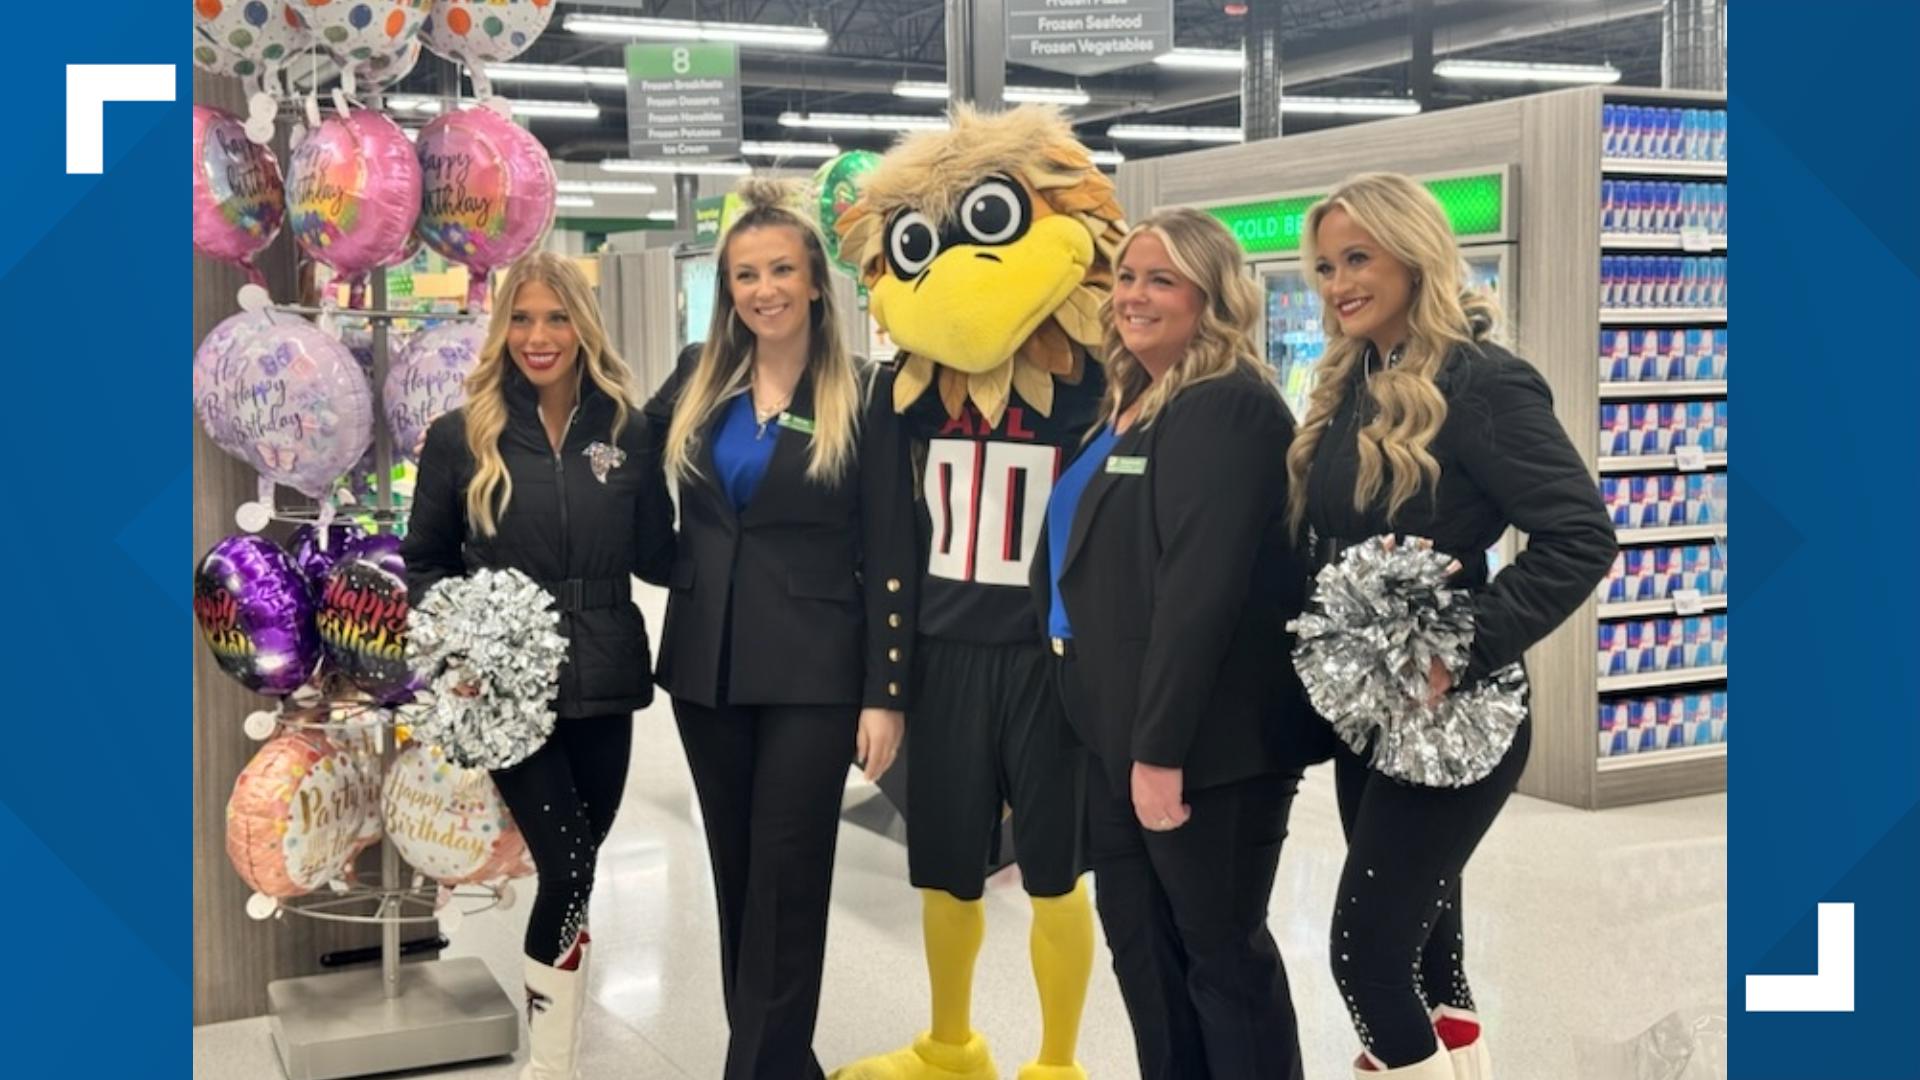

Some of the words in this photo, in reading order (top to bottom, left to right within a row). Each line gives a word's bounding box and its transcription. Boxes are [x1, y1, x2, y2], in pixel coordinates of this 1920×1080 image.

[1038, 17, 1083, 31] Frozen
[1085, 14, 1143, 30] Seafood
[1030, 40, 1076, 55] Frozen
[1077, 37, 1154, 56] Vegetables
[672, 47, 690, 74] 8
[641, 80, 673, 92] Frozen
[646, 96, 678, 107] Frozen
[648, 112, 679, 123] Frozen
[648, 128, 679, 138] Frozen
[662, 143, 677, 154] Ice
[678, 143, 709, 153] Cream
[1233, 216, 1278, 240] COLD
[233, 377, 286, 412] Happy
[229, 410, 303, 444] Birthday
[923, 438, 1062, 587] 00
[388, 770, 443, 815] Happy
[384, 800, 485, 862] Birthday
